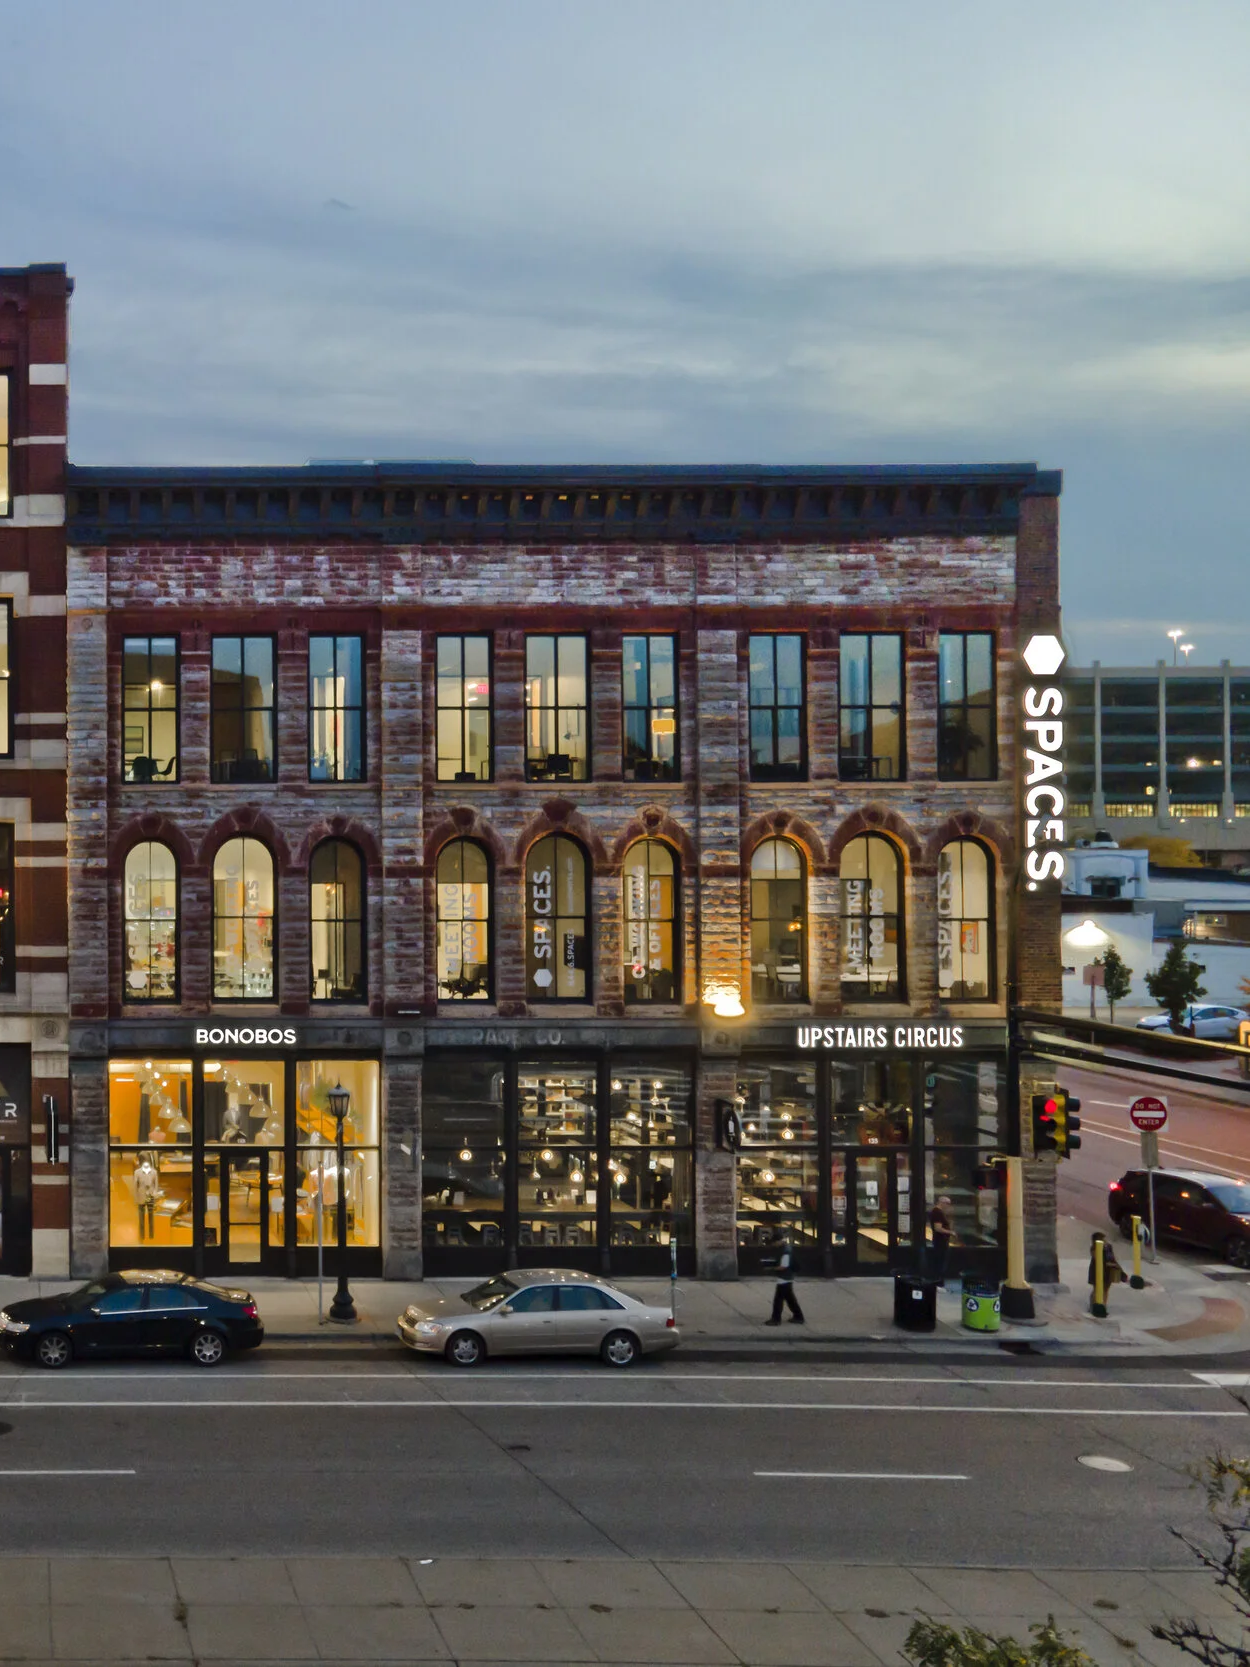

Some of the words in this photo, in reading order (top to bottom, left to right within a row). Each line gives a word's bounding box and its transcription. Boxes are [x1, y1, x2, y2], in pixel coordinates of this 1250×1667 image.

[1025, 687, 1064, 891] SPACES.
[444, 884, 459, 973] MEETING
[463, 892, 478, 963] ROOMS
[533, 865, 552, 959] SPACES.
[650, 879, 661, 953] OFFICES
[846, 880, 863, 969] MEETING
[869, 887, 884, 959] ROOMS
[196, 1028, 297, 1045] BONOBOS
[798, 1027, 888, 1048] UPSTAIRS
[894, 1027, 963, 1048] CIRCUS
